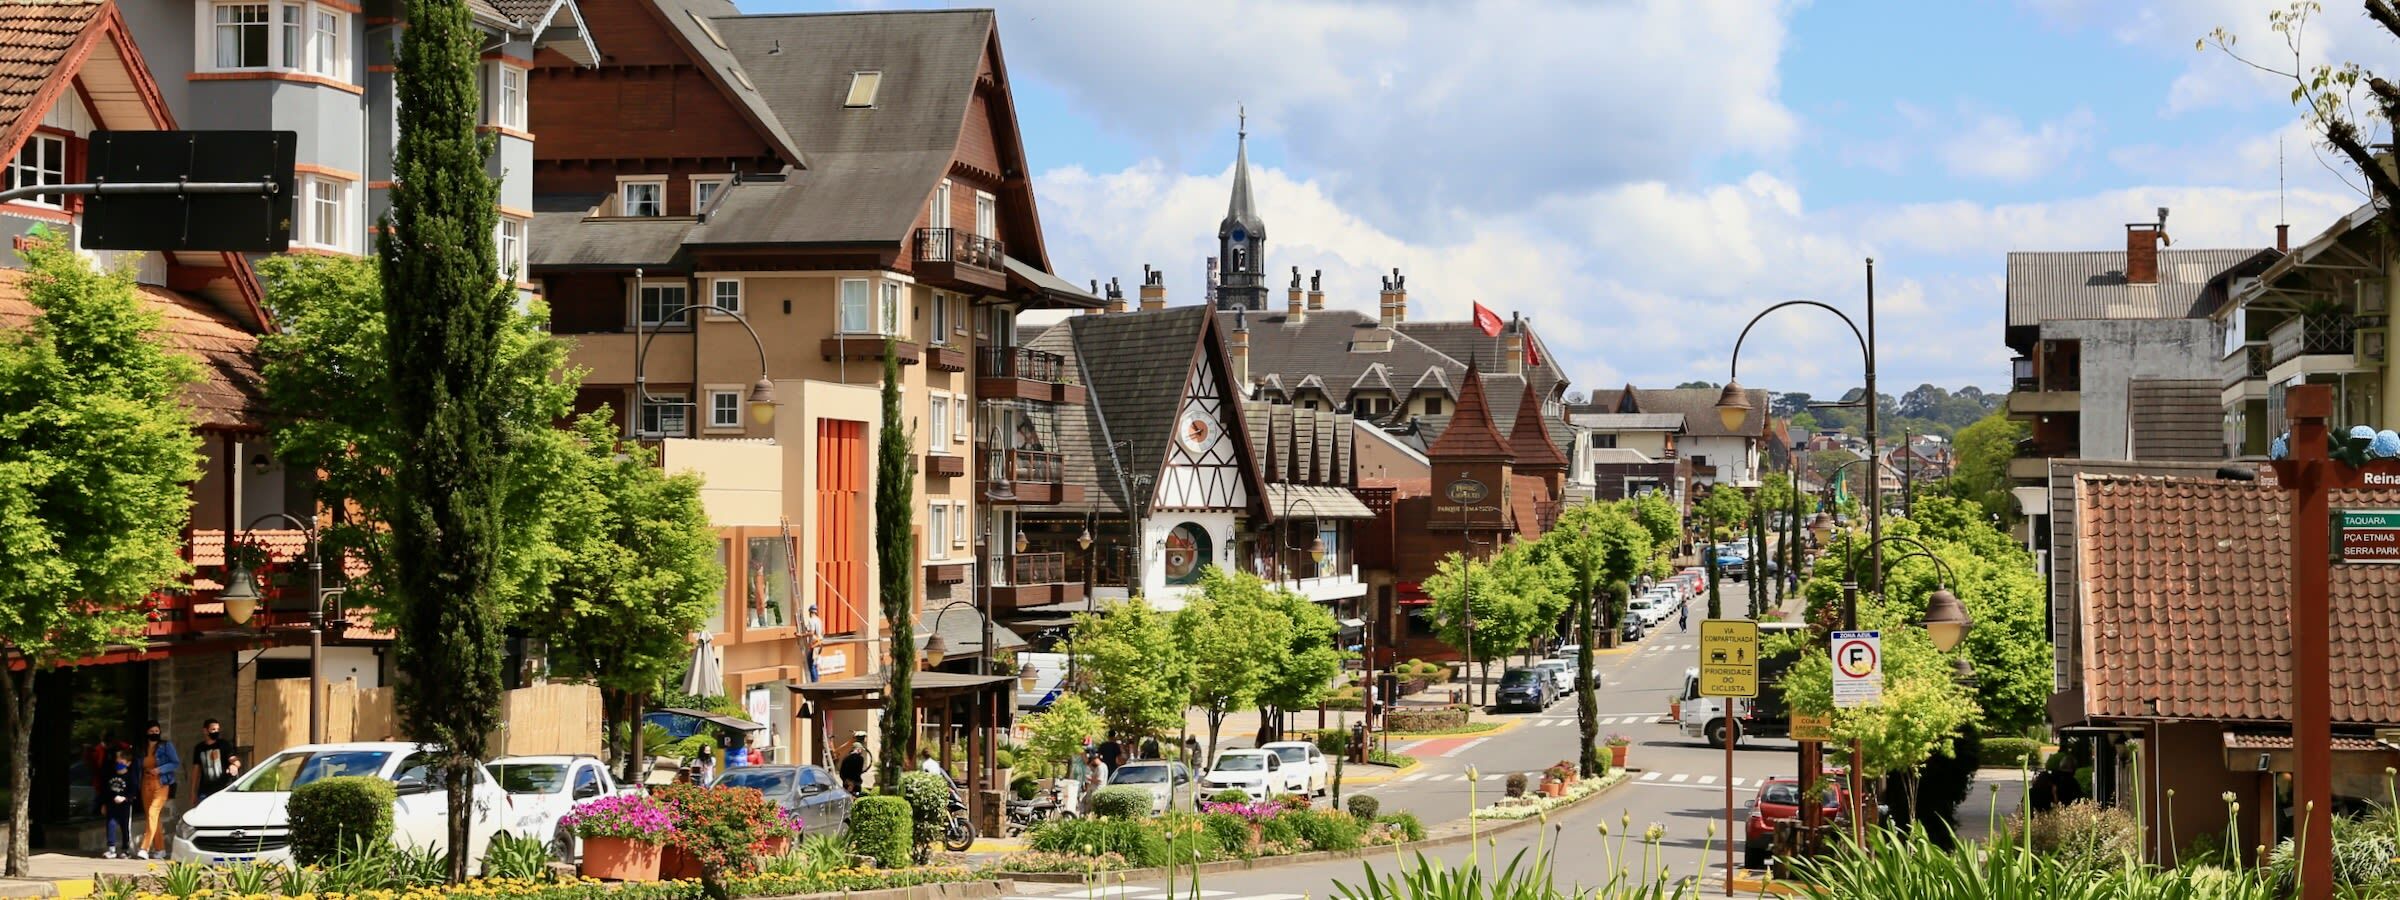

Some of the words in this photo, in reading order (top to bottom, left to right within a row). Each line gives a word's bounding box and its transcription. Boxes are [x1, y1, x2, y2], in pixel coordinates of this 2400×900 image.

[2364, 472, 2400, 484] Reina
[2344, 516, 2386, 525] TAQUARA
[2344, 533, 2361, 542] PÇA
[2363, 533, 2395, 542] ETNIAS
[2344, 547, 2374, 555] SERRA
[2376, 547, 2399, 555] PARK
[1704, 668, 1753, 676] PRIORIDADE
